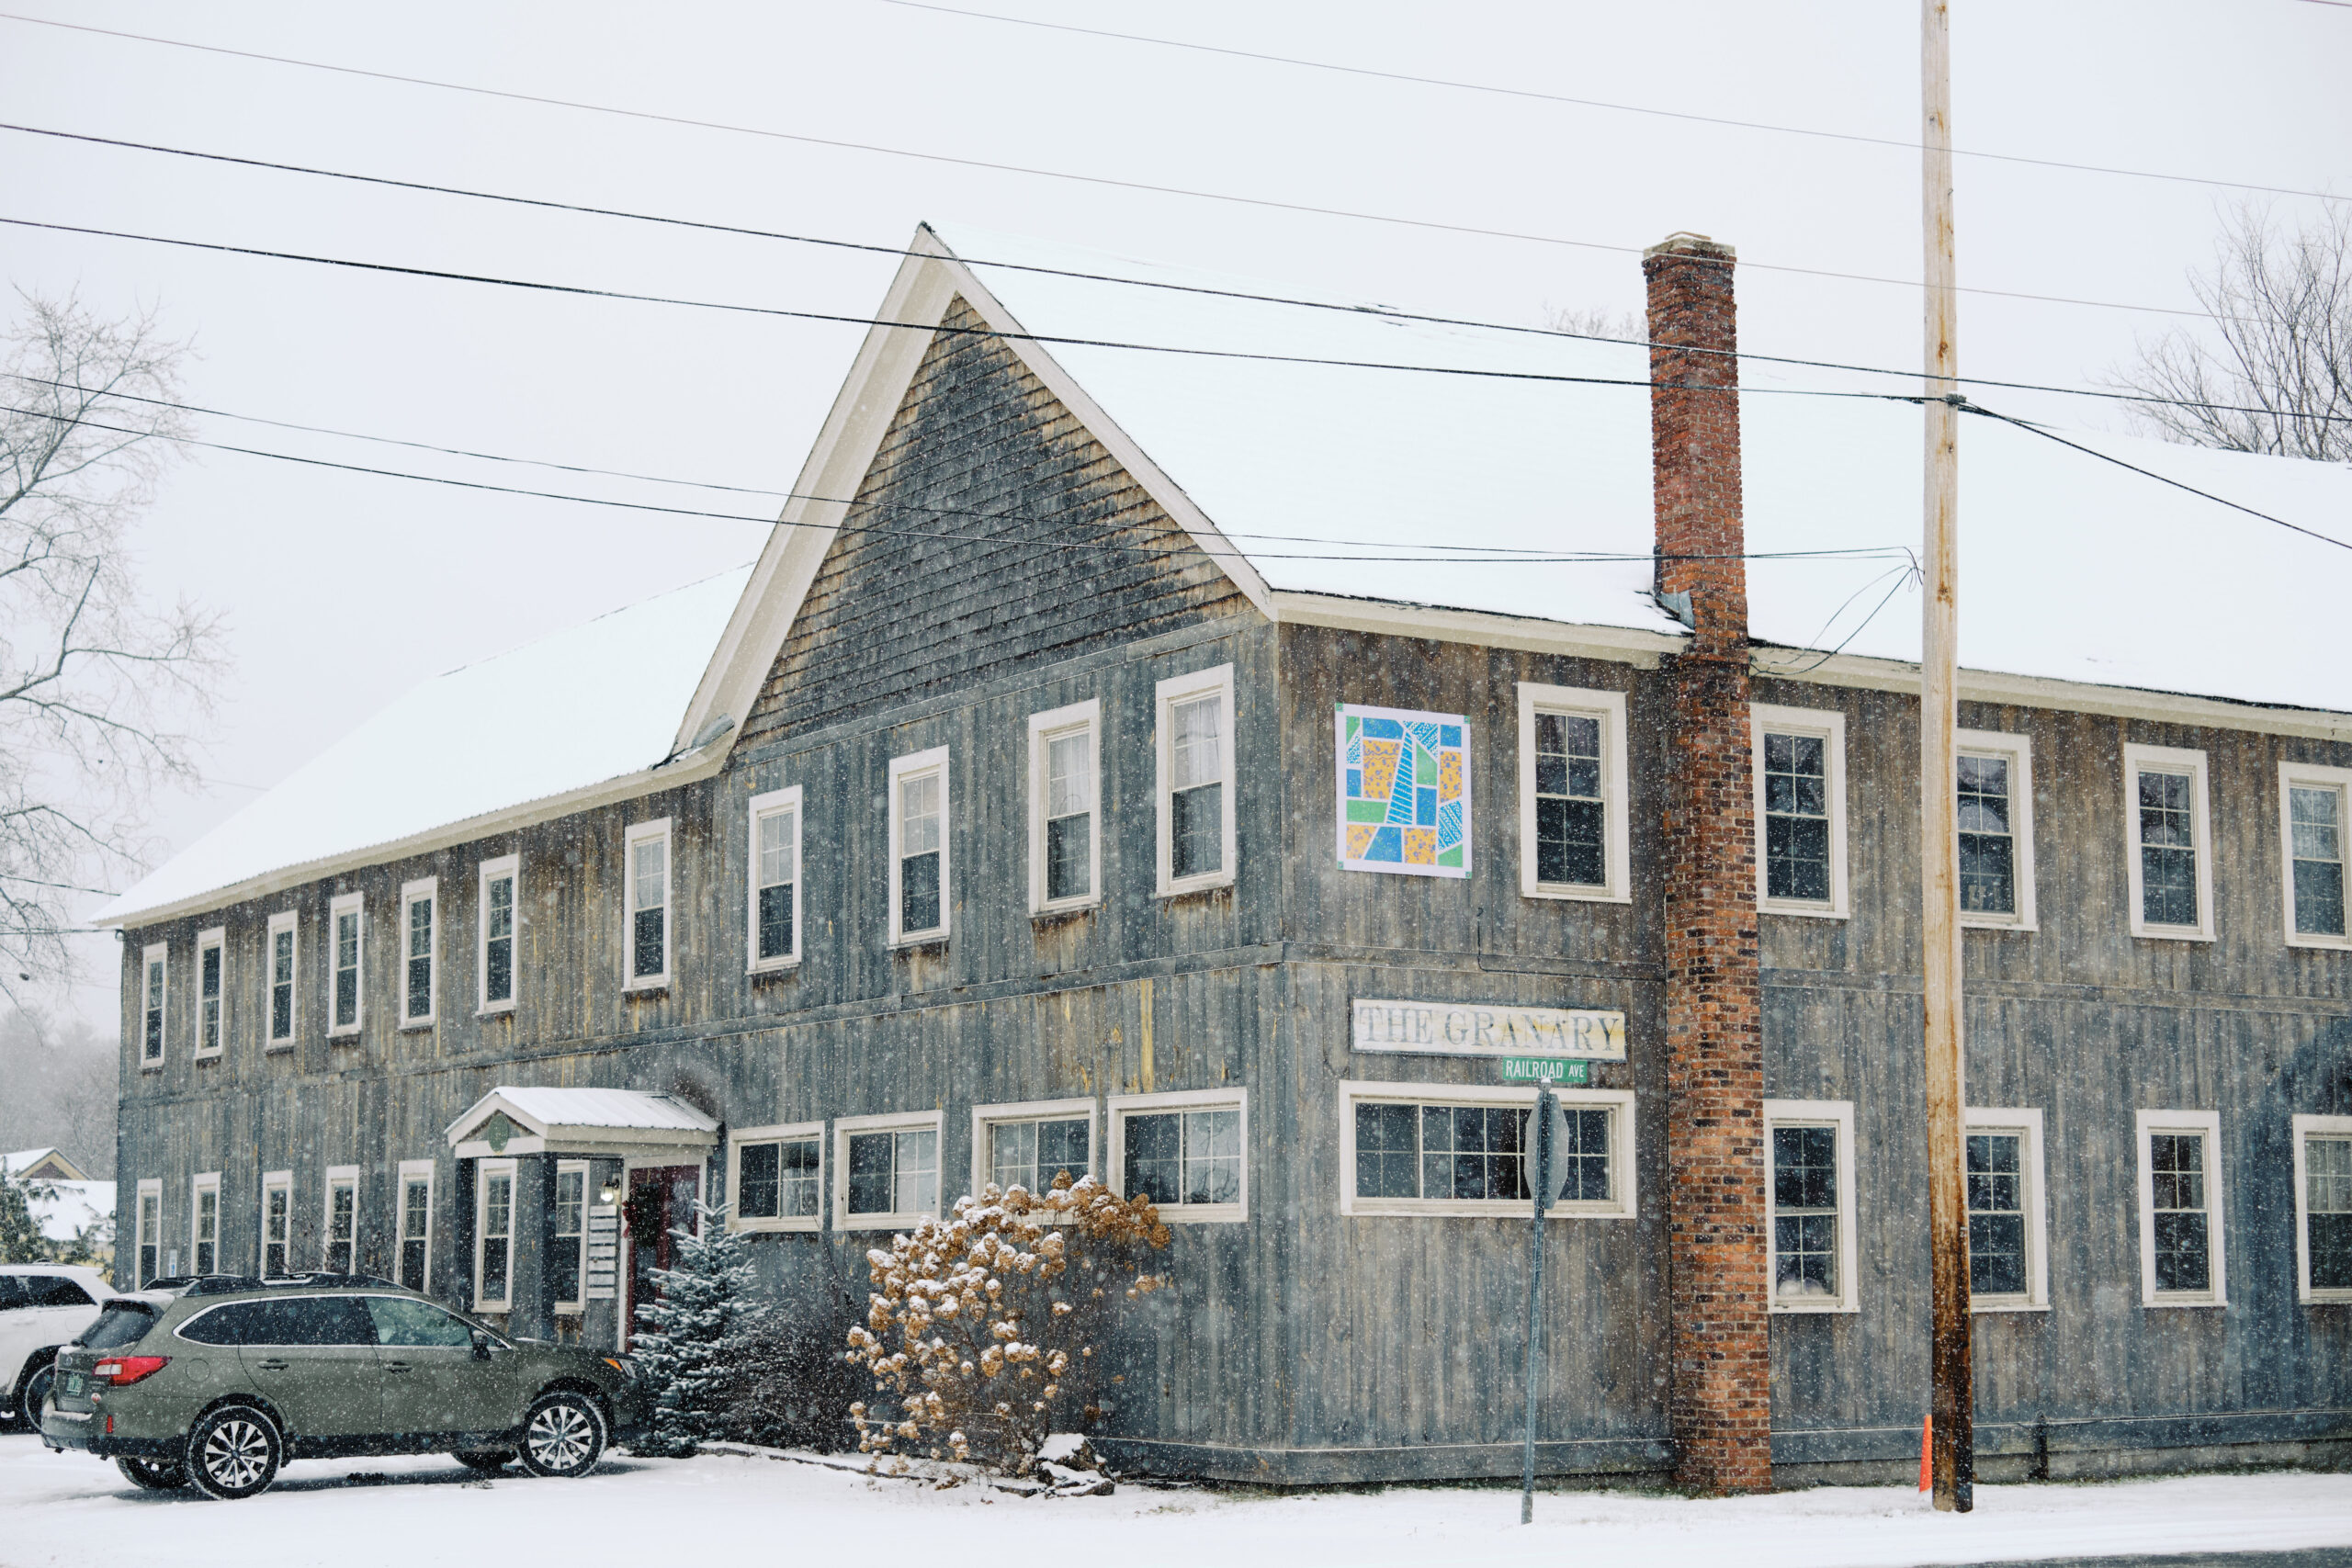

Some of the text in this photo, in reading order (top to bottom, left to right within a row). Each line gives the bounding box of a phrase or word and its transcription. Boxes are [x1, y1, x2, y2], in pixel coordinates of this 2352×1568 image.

[1359, 1006, 1620, 1052] THE GRANARY
[1506, 1060, 1585, 1079] RAILROAD AVE
